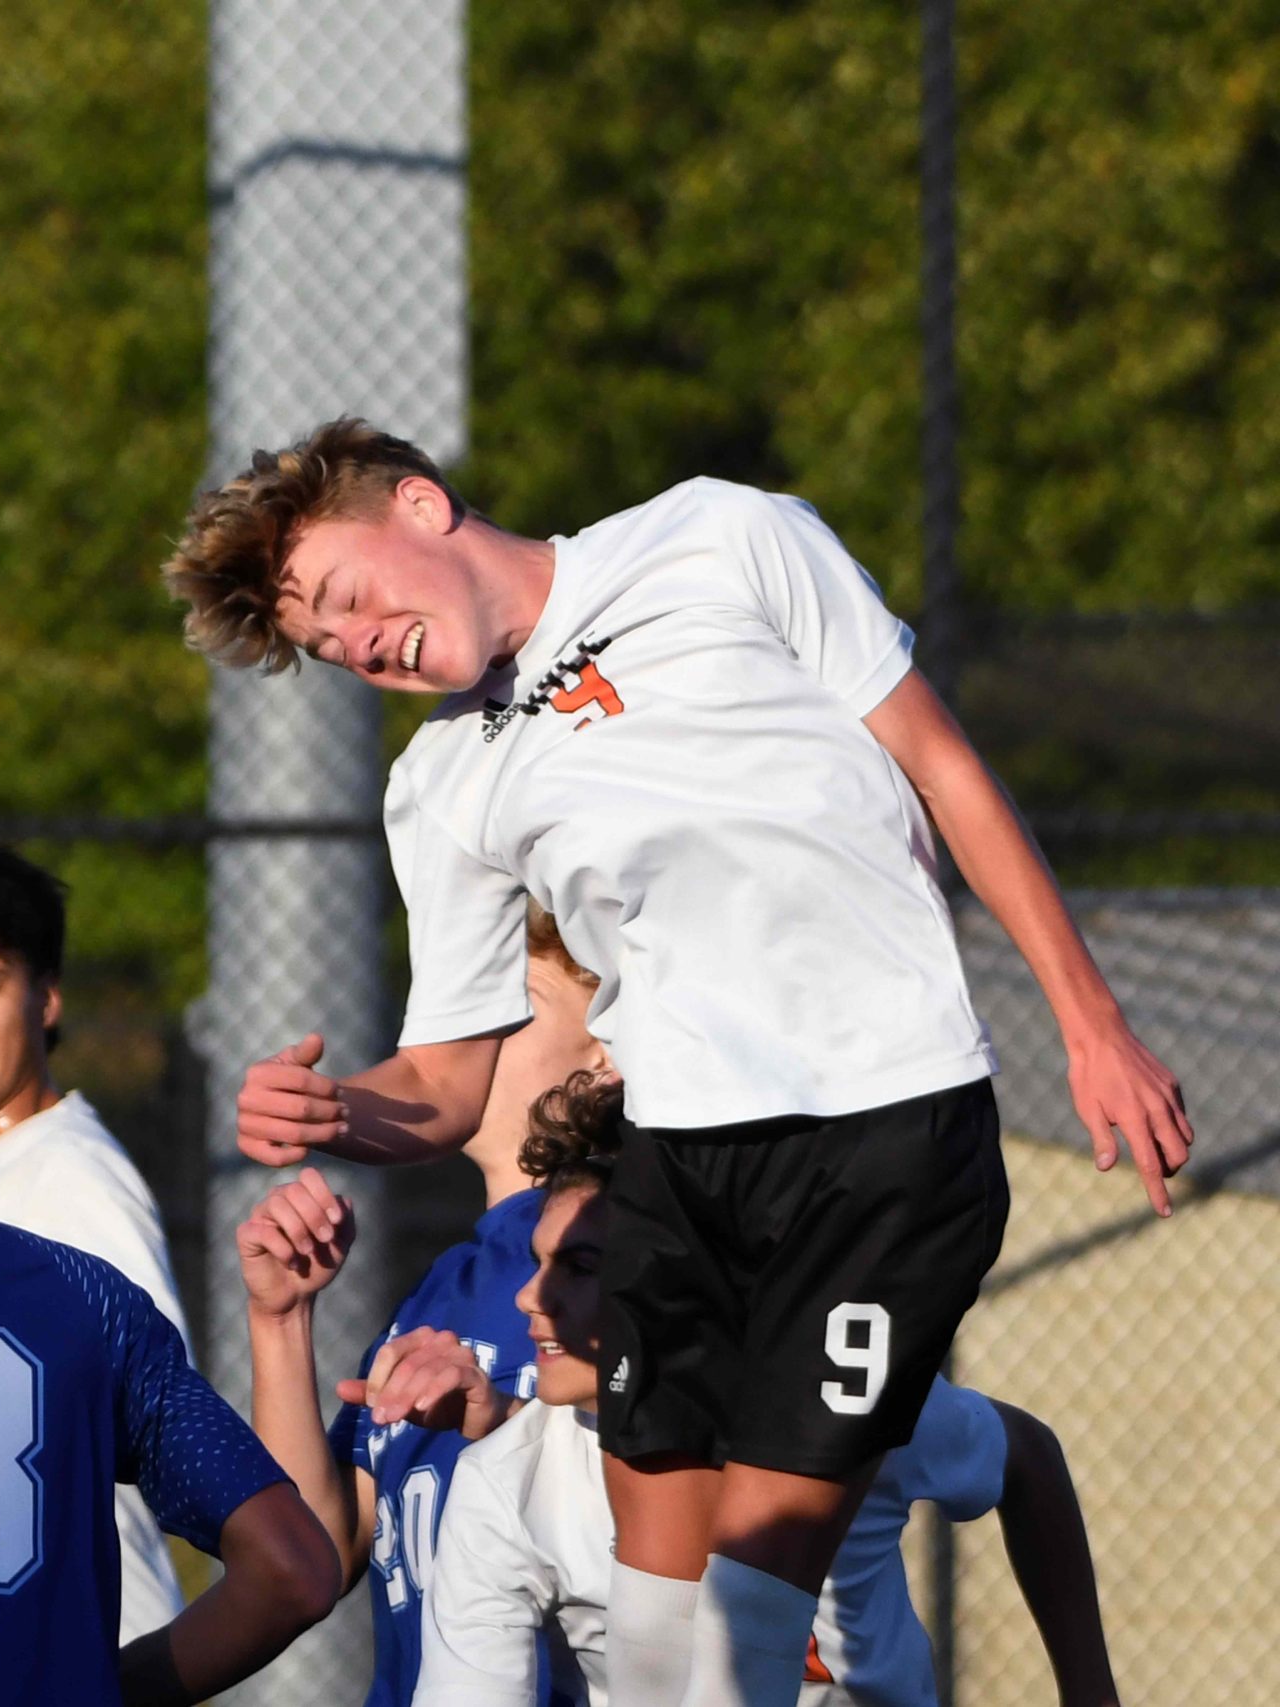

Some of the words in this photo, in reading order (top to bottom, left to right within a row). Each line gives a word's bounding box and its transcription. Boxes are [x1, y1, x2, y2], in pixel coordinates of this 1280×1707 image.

[483, 702, 521, 743] adidas
[821, 1302, 891, 1415] 9
[369, 1464, 442, 1613] 20
